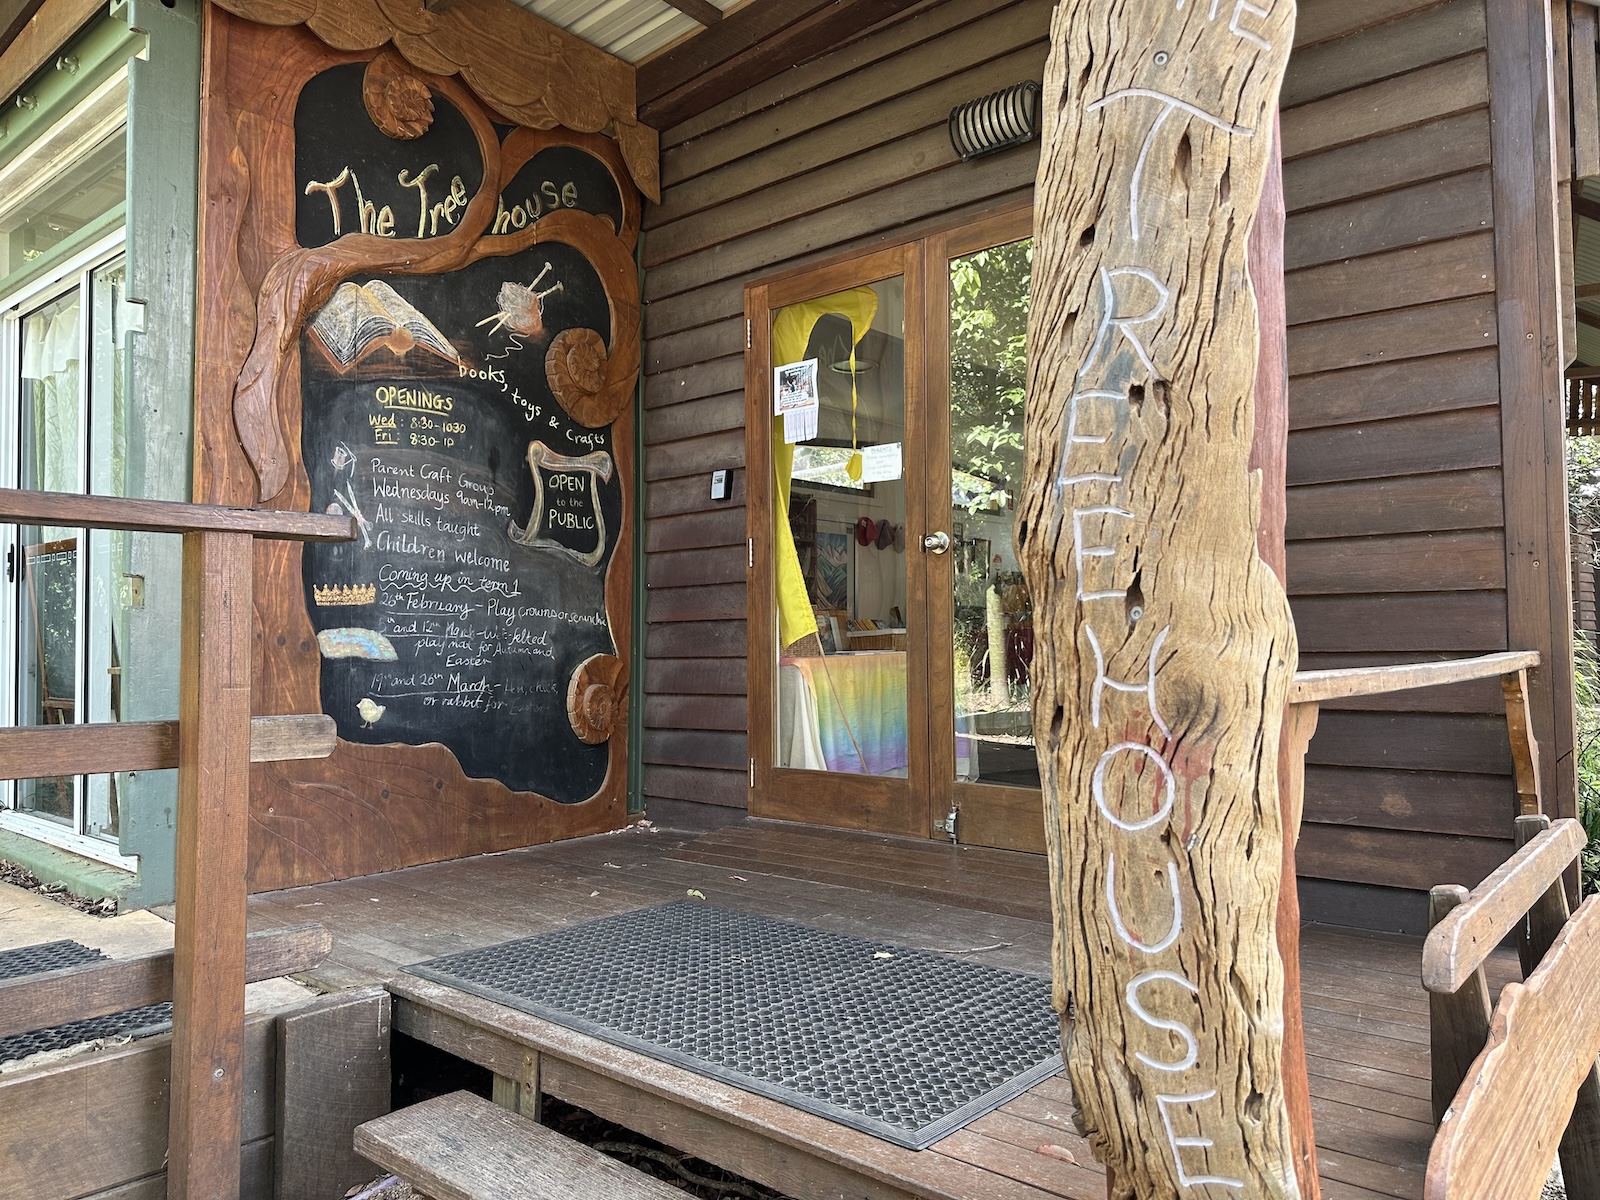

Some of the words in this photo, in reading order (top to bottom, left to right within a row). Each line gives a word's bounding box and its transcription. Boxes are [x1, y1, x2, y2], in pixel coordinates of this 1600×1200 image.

[305, 166, 396, 237] The
[398, 164, 467, 238] Tree
[492, 179, 578, 235] house
[375, 386, 454, 412] OPENINGS
[457, 354, 507, 392] books,
[511, 387, 542, 421] toys
[549, 416, 559, 429] &
[370, 457, 415, 478] Parent
[420, 461, 453, 484] Craft
[458, 474, 495, 497] Group
[549, 475, 585, 492] OPEN
[372, 477, 450, 511] Wednesdays
[556, 499, 568, 508] to
[569, 497, 584, 508] the
[376, 502, 394, 524] All
[401, 511, 432, 529] skills
[436, 519, 480, 542] taught
[549, 512, 595, 530] PUBLIC
[376, 530, 446, 562] Children
[378, 563, 428, 591] Coming
[434, 573, 452, 592] up
[457, 571, 473, 585] in
[479, 575, 509, 593] term
[405, 592, 476, 620] February
[487, 598, 516, 627] Play
[393, 620, 417, 634] and
[414, 640, 444, 657] play
[478, 642, 493, 657] for
[445, 653, 493, 668] Easter
[390, 675, 417, 689] and
[446, 672, 494, 696] March
[423, 697, 438, 707] or
[442, 693, 484, 709] rabbit
